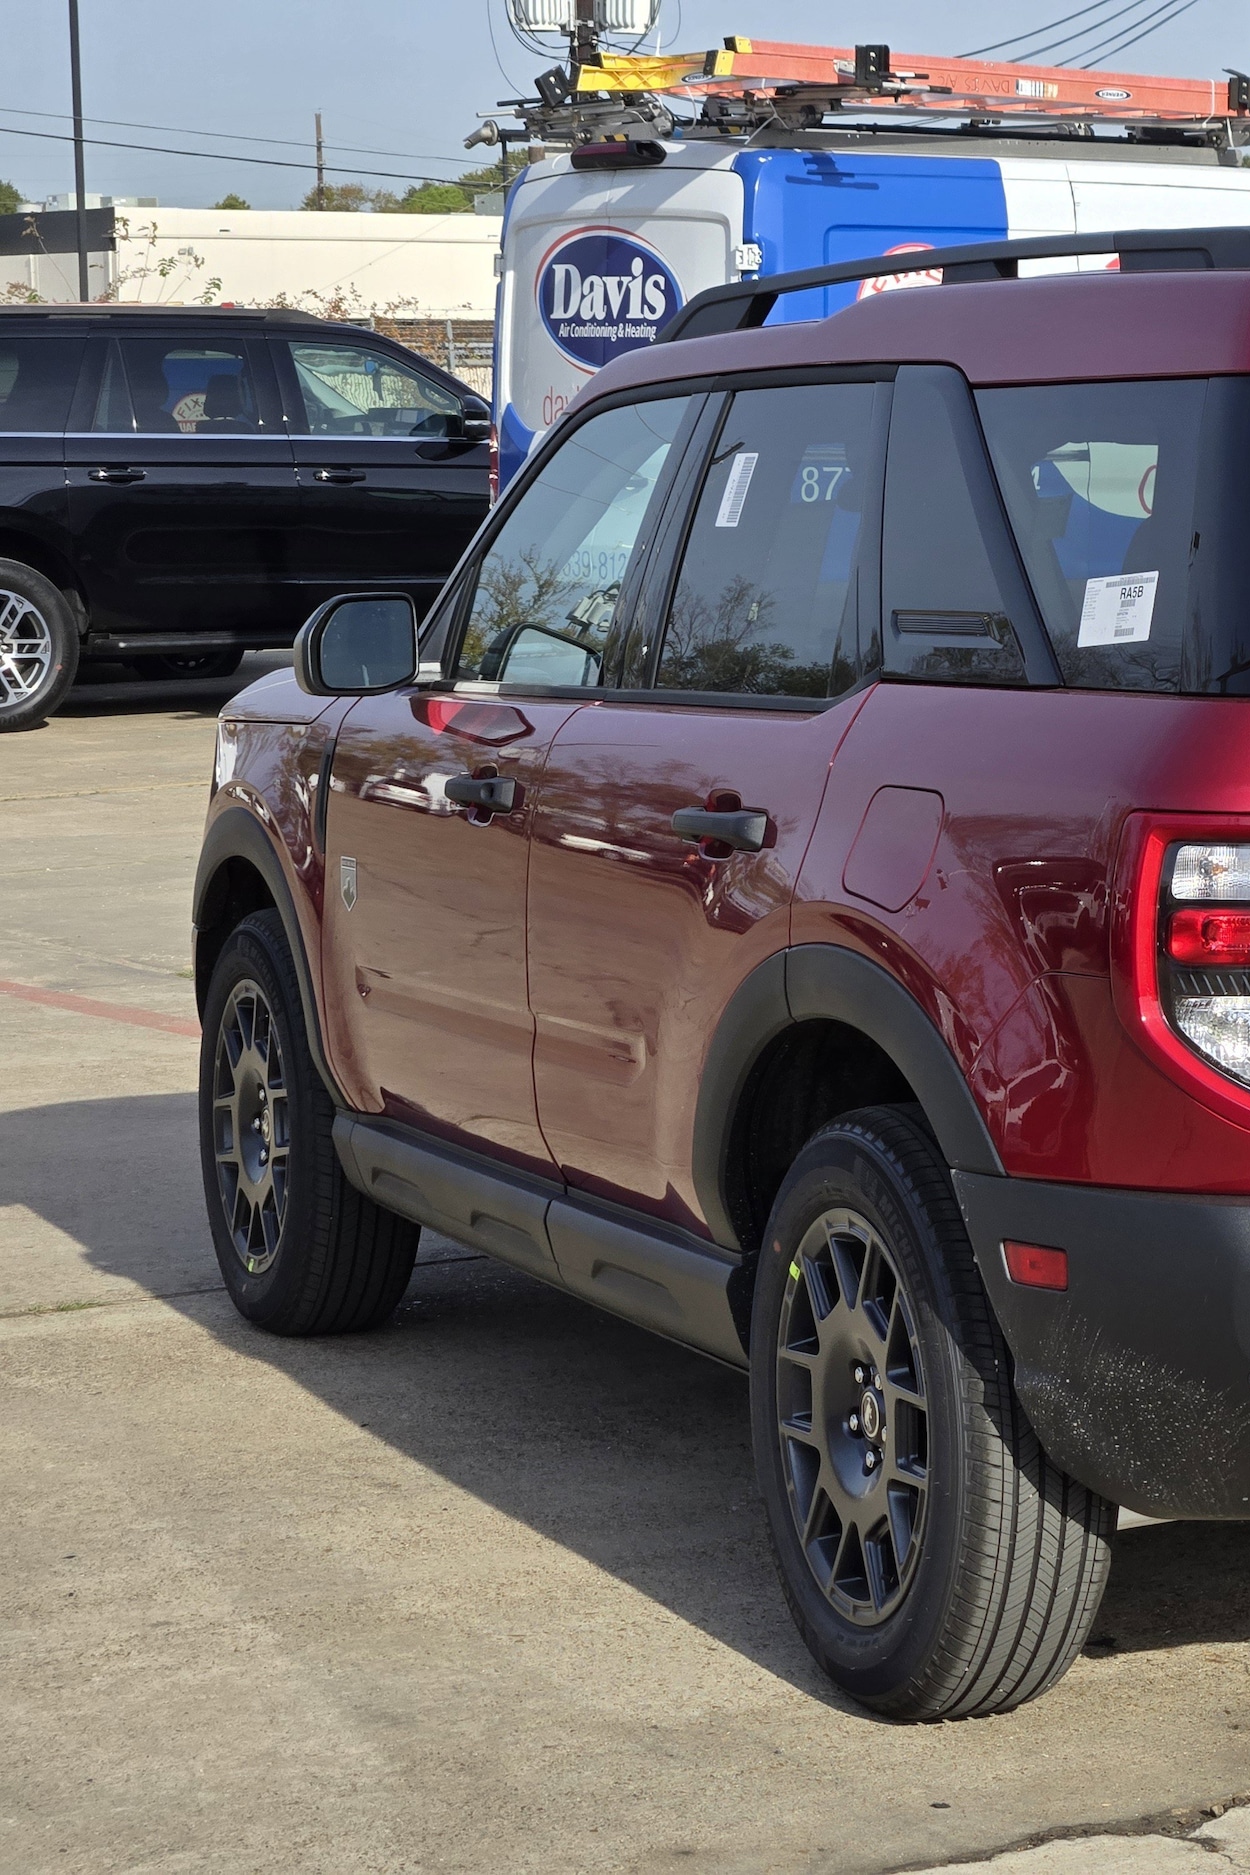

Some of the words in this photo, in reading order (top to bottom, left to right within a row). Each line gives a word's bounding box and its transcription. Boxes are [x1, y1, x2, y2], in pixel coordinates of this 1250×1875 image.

[964, 77, 1010, 94] DAVIS
[550, 257, 666, 320] Davis
[559, 323, 570, 338] Air
[570, 322, 617, 342] Conditioning
[618, 324, 624, 338] &
[625, 322, 657, 342] Heating
[1120, 585, 1144, 600] RA5B
